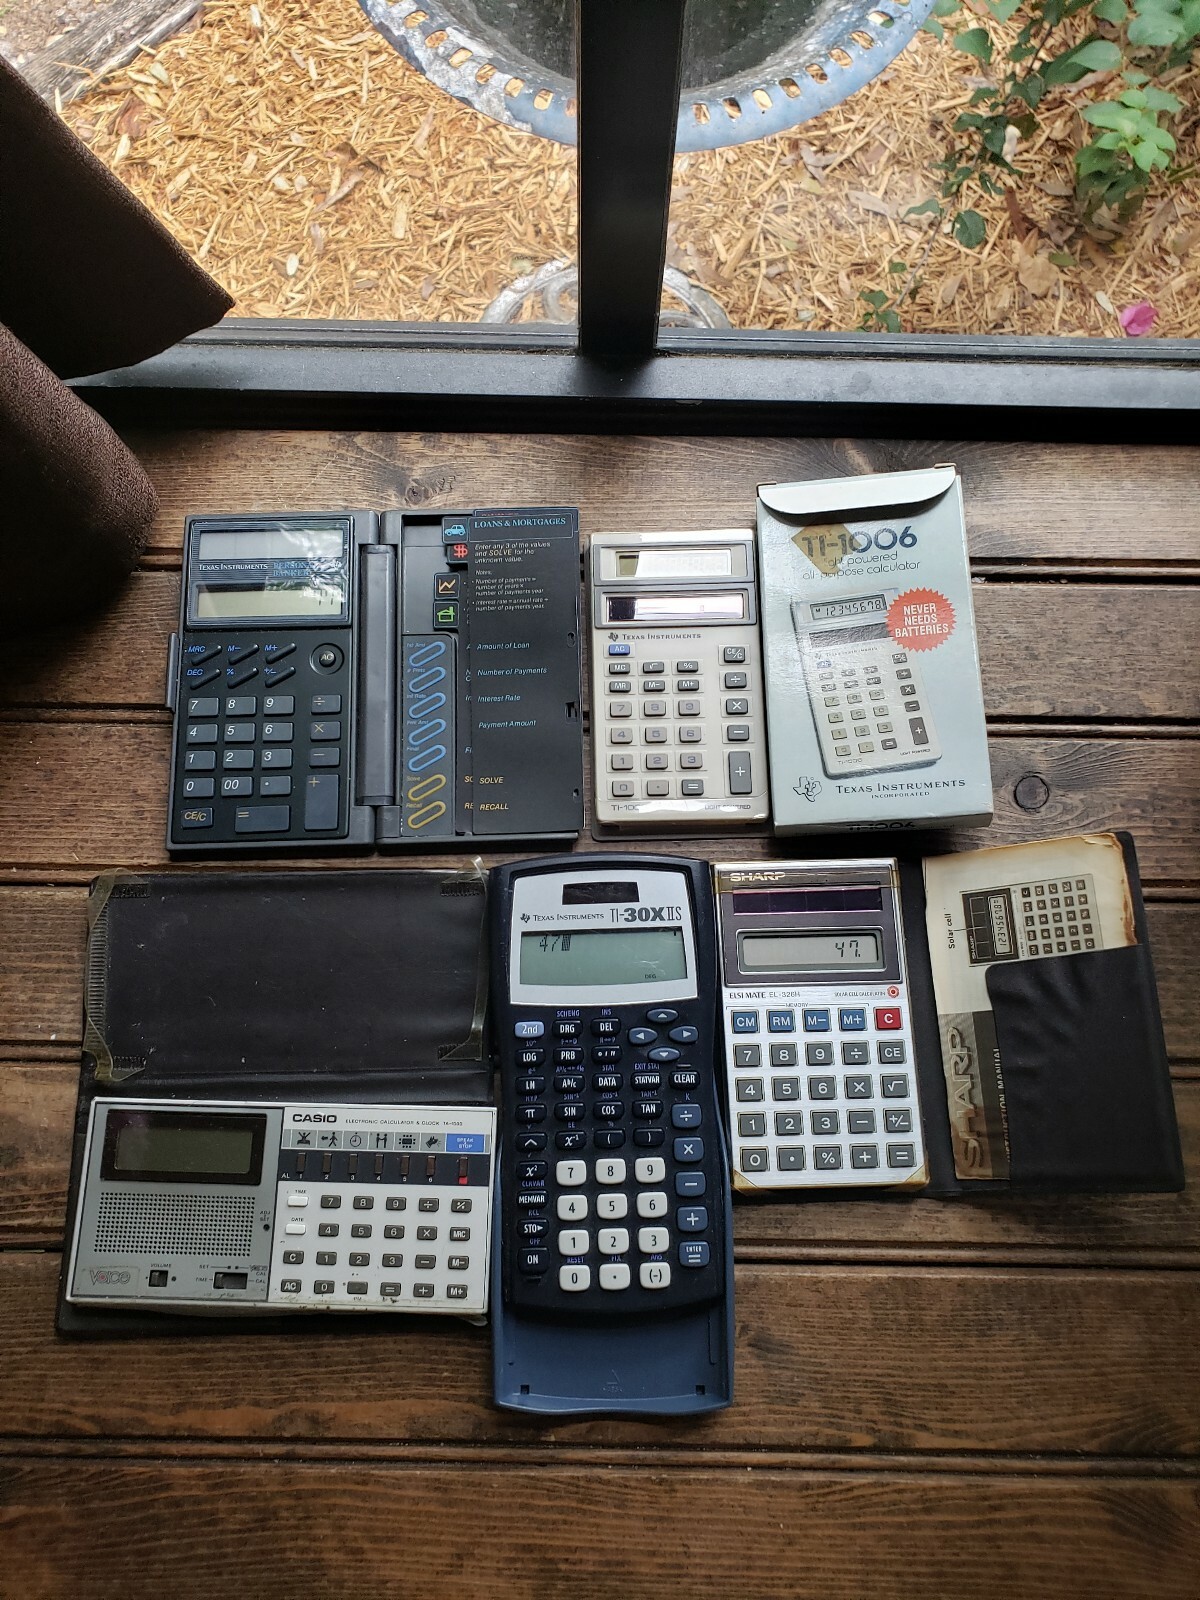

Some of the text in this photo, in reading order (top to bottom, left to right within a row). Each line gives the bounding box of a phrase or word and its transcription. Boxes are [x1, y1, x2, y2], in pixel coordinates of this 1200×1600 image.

[512, 518, 566, 526] MORTGAGES
[802, 525, 917, 557] TI-1006
[847, 551, 898, 567] powered
[866, 561, 920, 574] calculator
[903, 603, 937, 615] NEVER
[904, 614, 937, 626] NEEDS
[895, 623, 949, 637] BATTERIES
[514, 667, 548, 676] Payments
[190, 698, 274, 710] 7 8 9
[478, 721, 508, 729] Payment
[190, 726, 235, 737] 4 5
[224, 780, 239, 790] 00
[836, 779, 966, 794] TEXAS INSTRUMENTS
[871, 791, 930, 799] INCORPORATED
[184, 812, 207, 822] CE/C
[730, 872, 785, 882] SHARP
[736, 1017, 755, 1027] CM
[772, 1016, 790, 1026] RM
[844, 1014, 862, 1024] M+
[884, 1014, 894, 1024] C
[522, 1024, 538, 1034] 2nd
[559, 1024, 575, 1033] DRG
[600, 1022, 613, 1031] DEL
[522, 1052, 537, 1061] LOG
[561, 1052, 576, 1060] PRB
[743, 1048, 900, 1061] 7 8 9 CE
[598, 1078, 617, 1087] DATA
[634, 1076, 660, 1084] STATVAR
[674, 1074, 696, 1083] CLEAR
[525, 1081, 535, 1089] LN
[745, 1083, 828, 1096] 4 5 6
[948, 1026, 984, 1168] SHARP
[564, 1106, 576, 1116] SIN
[601, 1106, 615, 1115] COS
[641, 1104, 656, 1113] TAN
[292, 1114, 337, 1123] CASIO
[785, 1118, 794, 1130] 2
[821, 1117, 831, 1129] 3
[750, 1152, 835, 1166] 0 %
[568, 1164, 654, 1179] 7 8 9
[518, 1196, 545, 1204] MEMVAR
[568, 1199, 656, 1213] 4 5 6
[524, 1224, 537, 1233] STO
[453, 1230, 465, 1238] MRC
[610, 1235, 657, 1247] 2 3
[527, 1255, 539, 1264] ON
[572, 1273, 578, 1284] 0
[284, 1282, 296, 1290] AC
